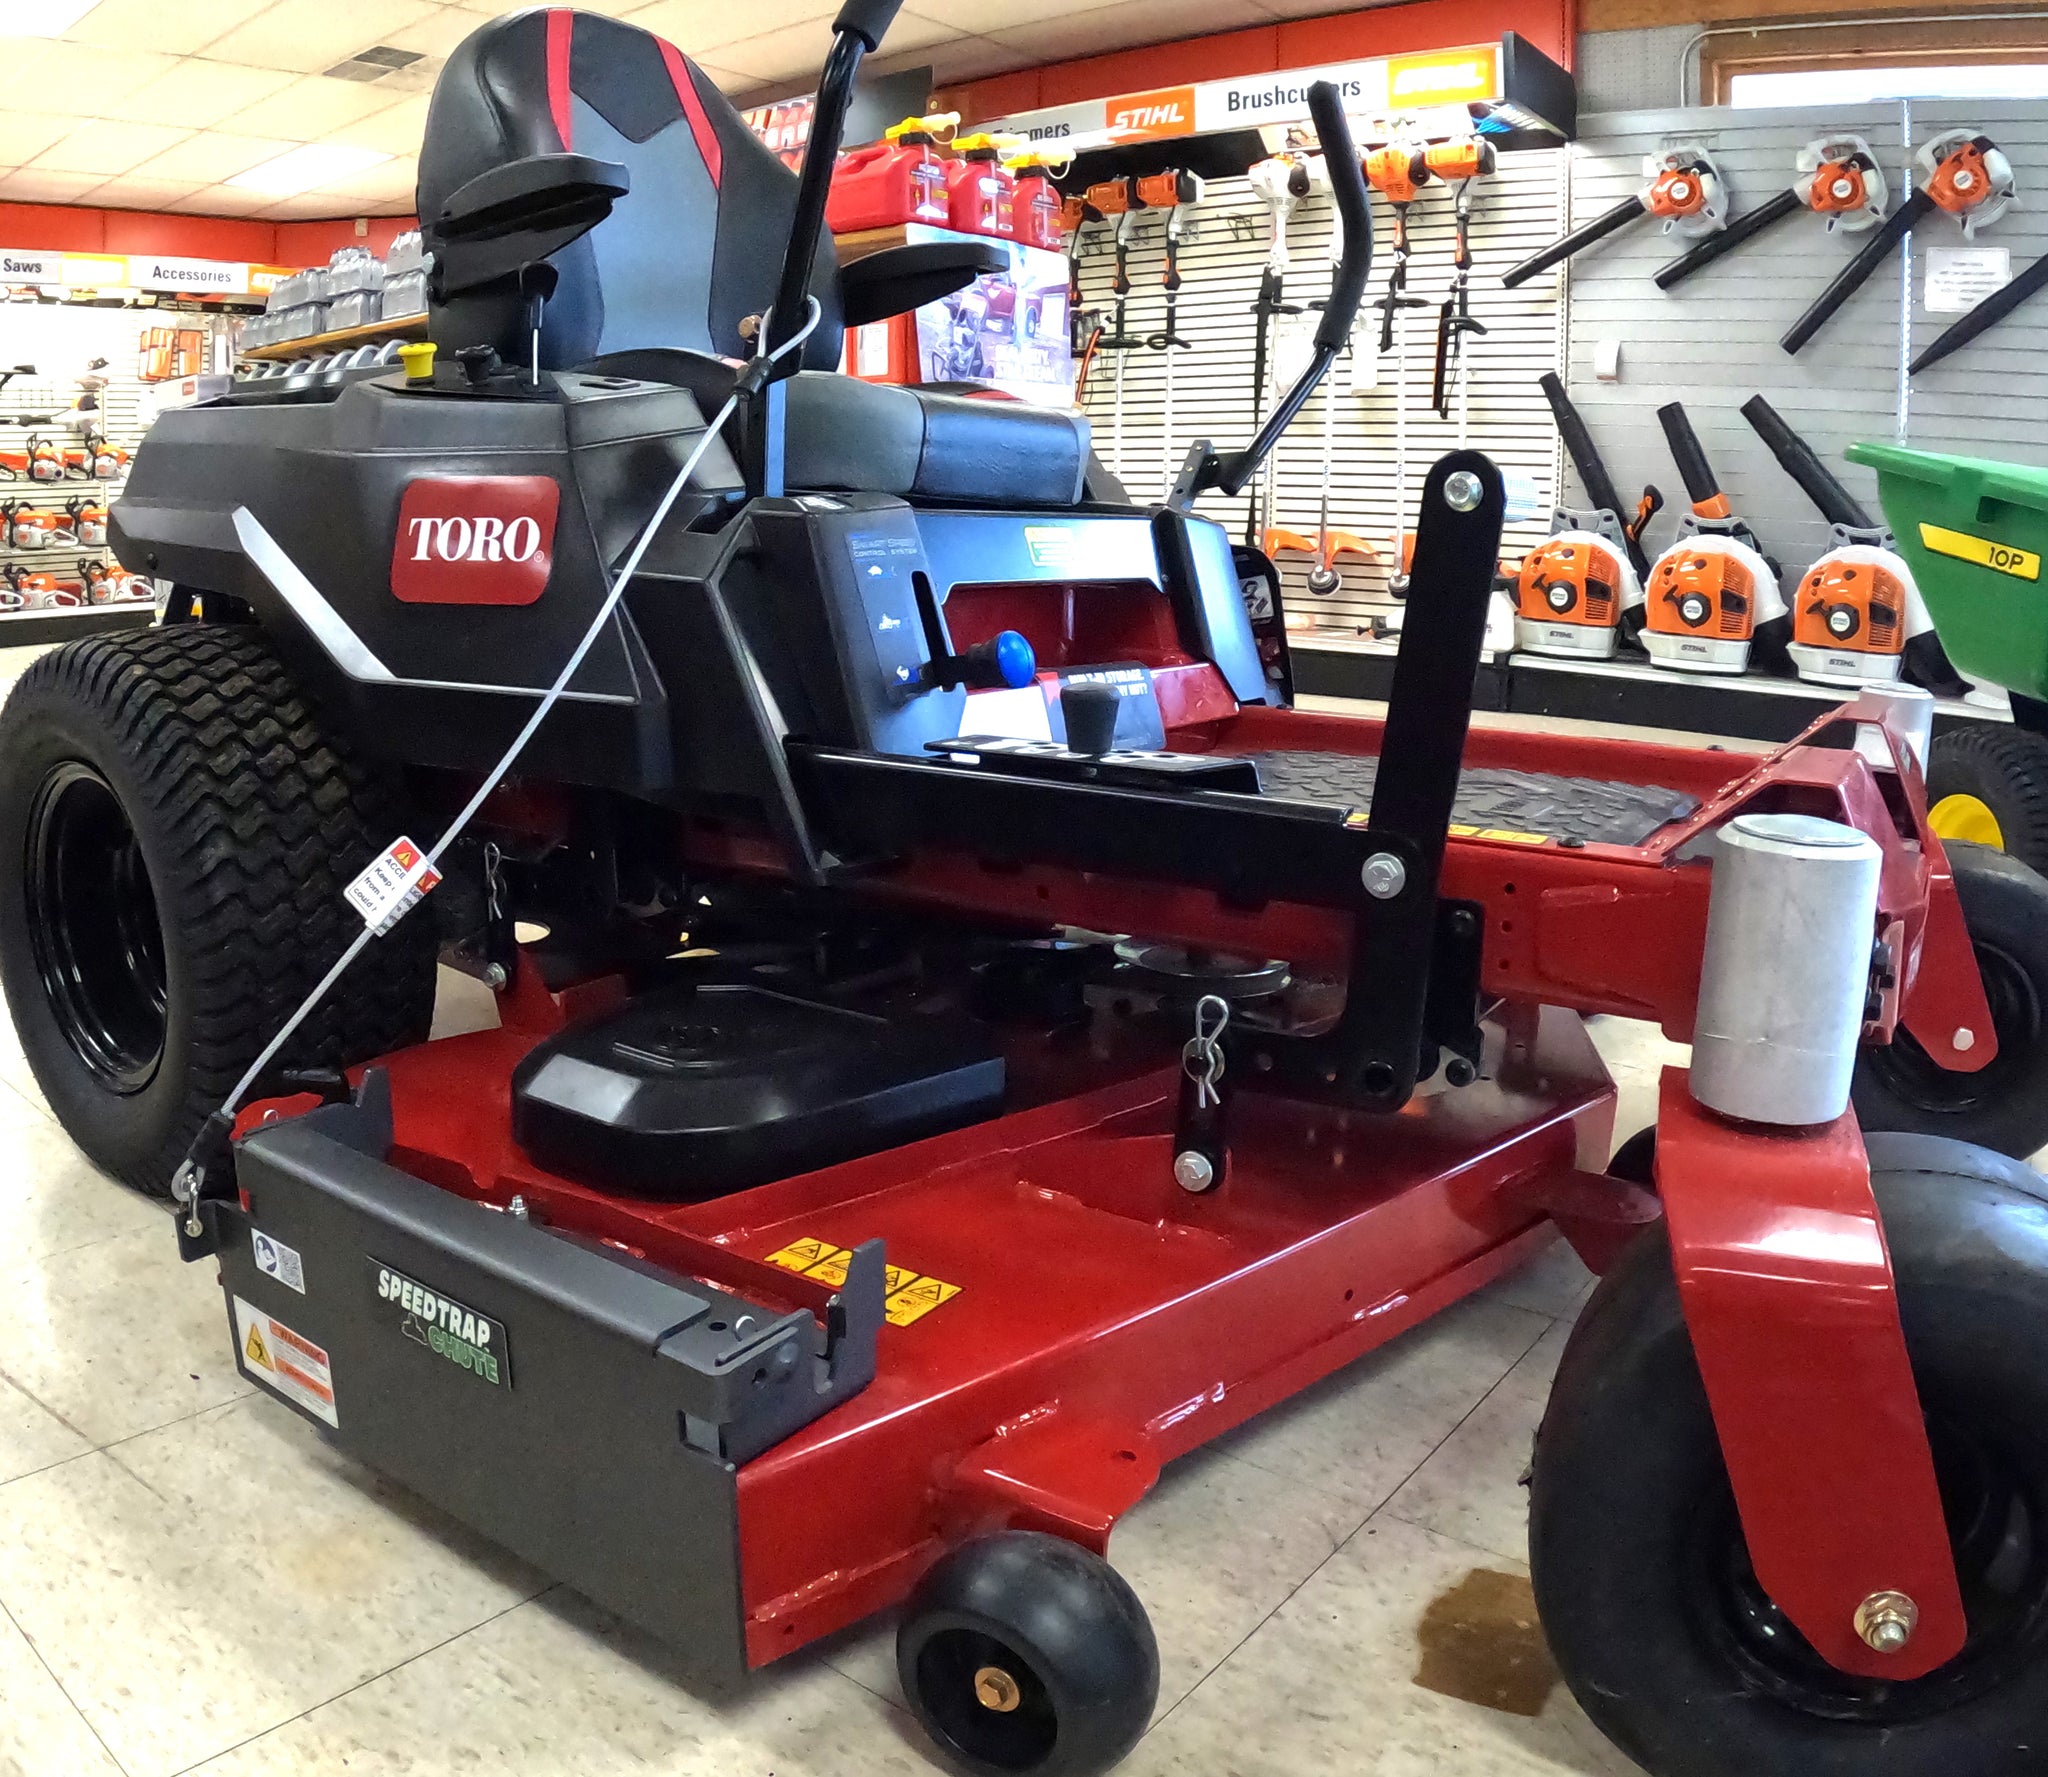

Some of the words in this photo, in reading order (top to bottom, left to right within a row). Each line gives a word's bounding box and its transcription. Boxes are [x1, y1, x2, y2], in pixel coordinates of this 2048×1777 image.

[1228, 79, 1361, 112] Brushcurs
[1114, 102, 1185, 130] STIHL
[3, 258, 42, 273] Saws
[152, 265, 231, 282] Accessories
[408, 516, 542, 562] TORO
[1988, 546, 2025, 570] 10P
[1549, 630, 1575, 639] STIHL
[1680, 644, 1708, 653] STIHL
[1828, 658, 1856, 668] STIHL
[364, 876, 381, 896] from
[374, 867, 393, 888] Keep
[353, 888, 374, 908] could
[378, 1269, 491, 1348] SPEEDTRAP
[427, 1325, 500, 1385] CHUTE
